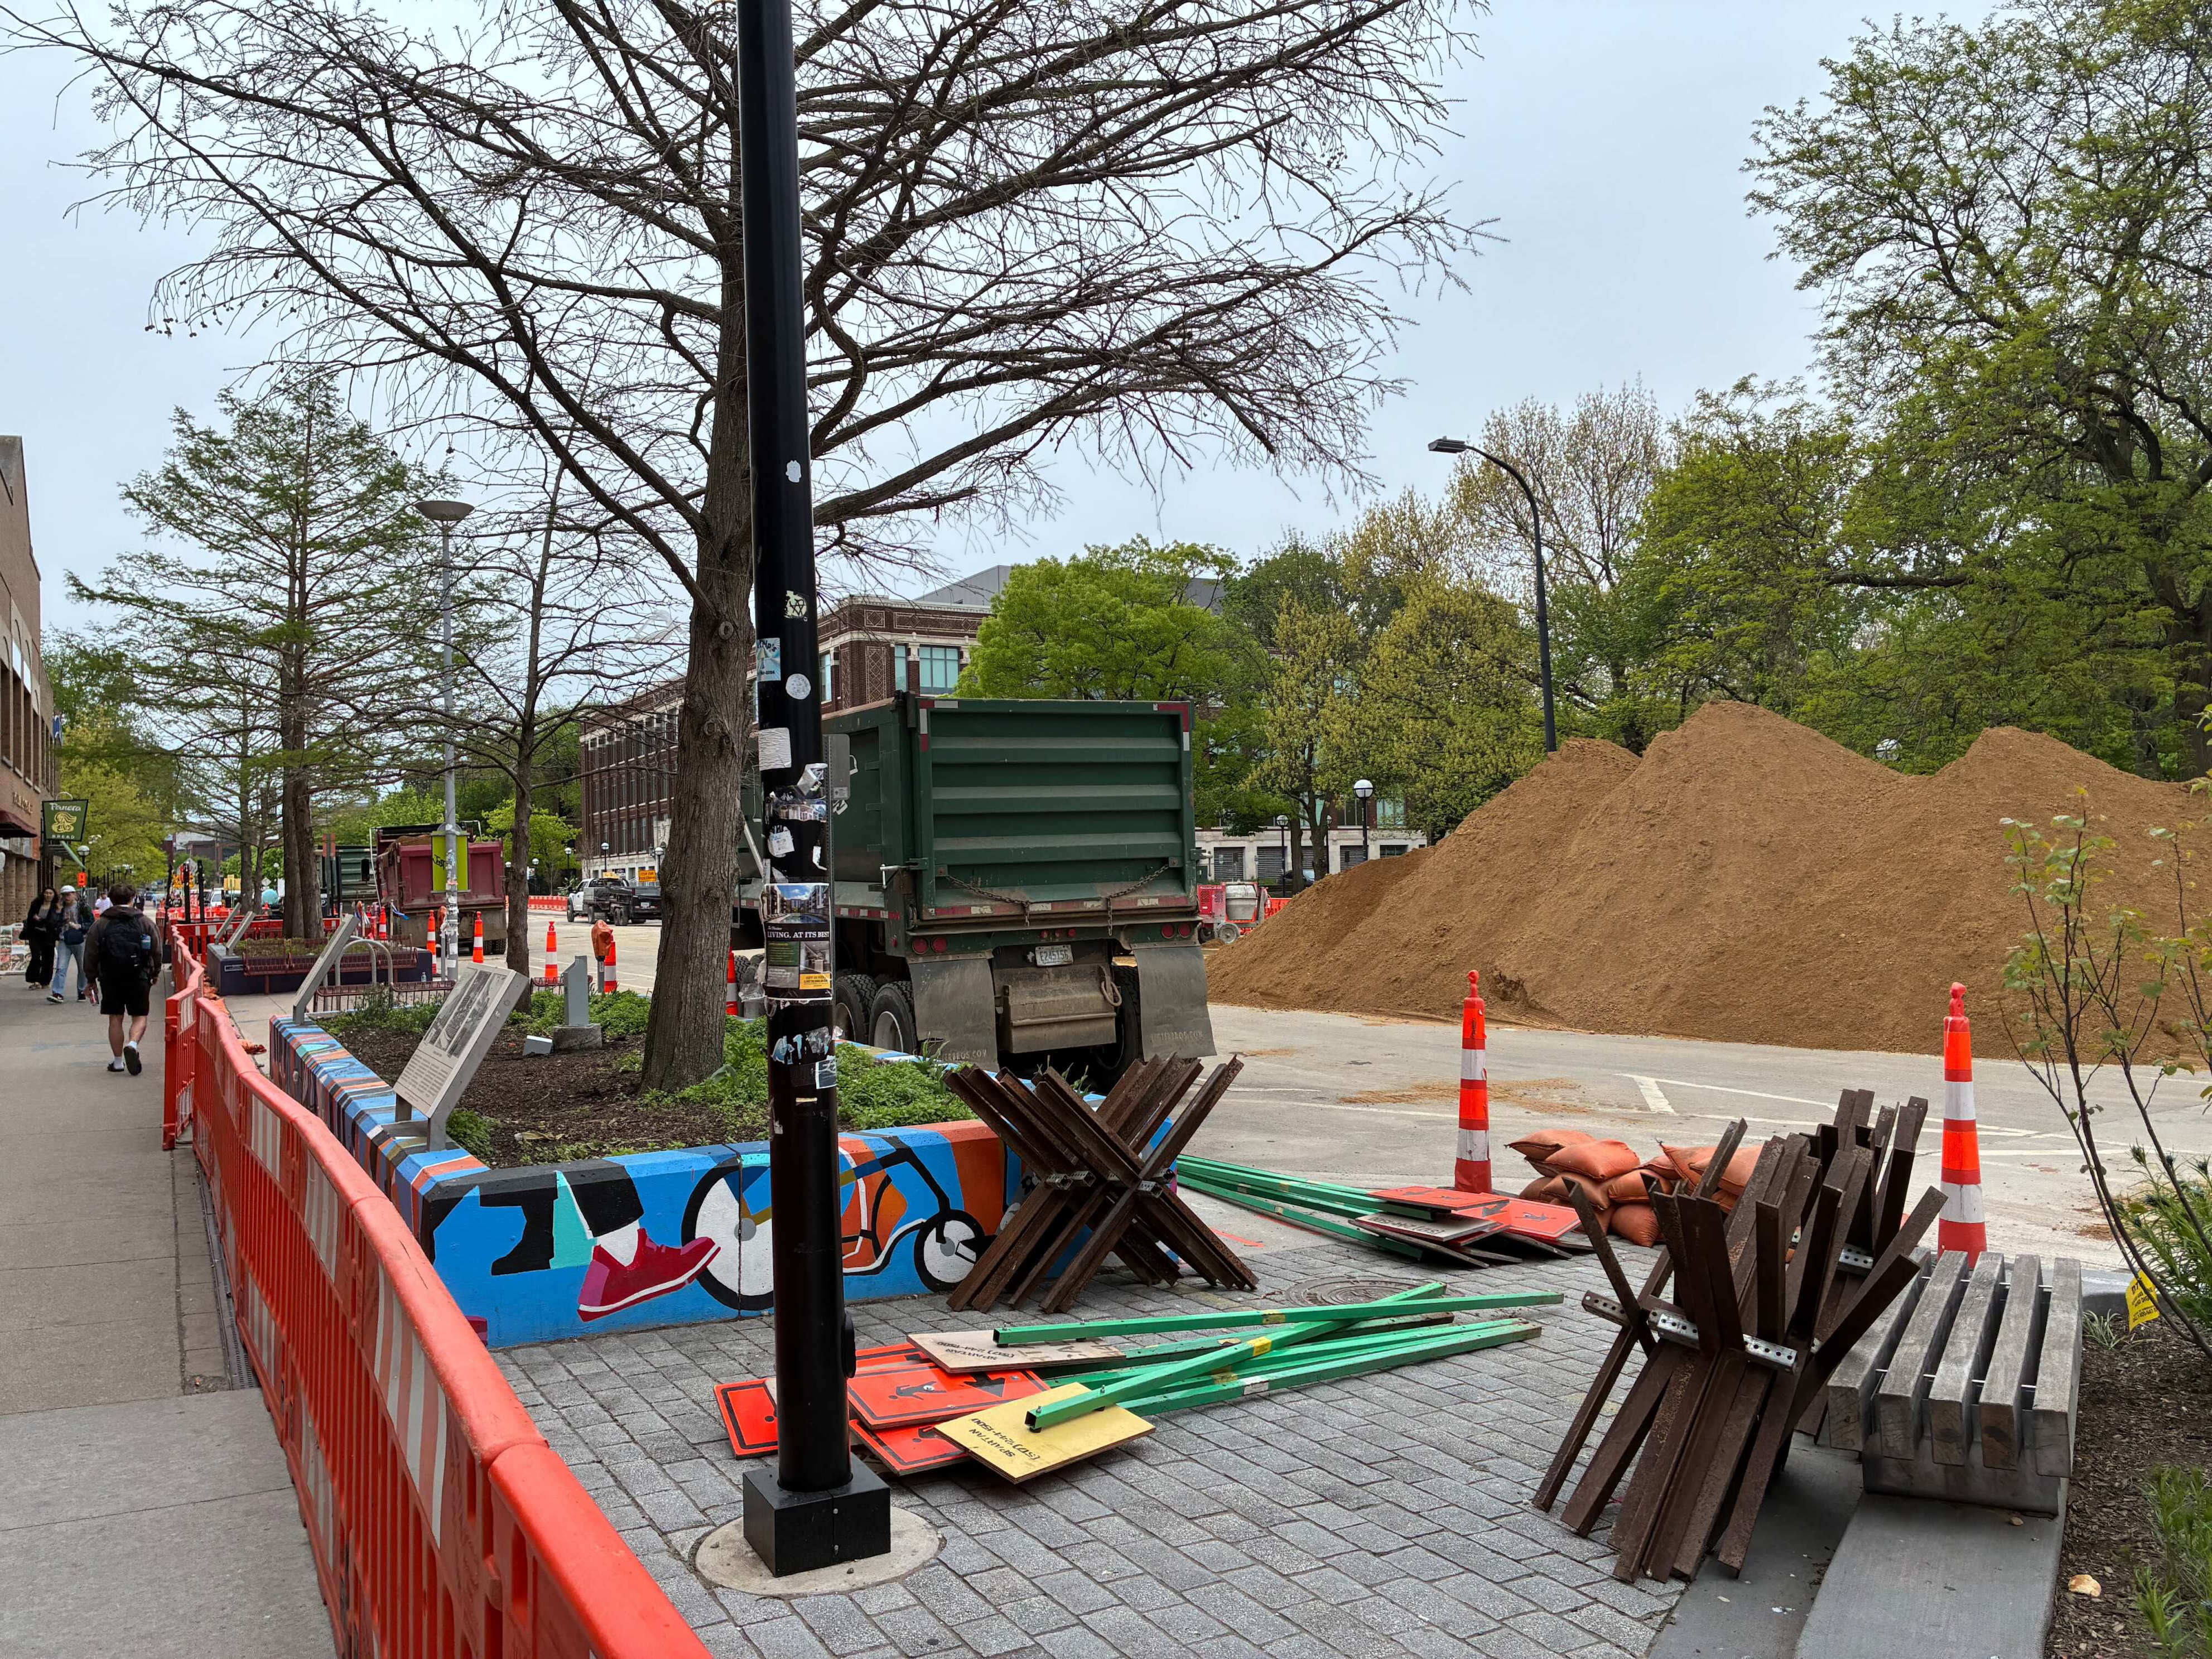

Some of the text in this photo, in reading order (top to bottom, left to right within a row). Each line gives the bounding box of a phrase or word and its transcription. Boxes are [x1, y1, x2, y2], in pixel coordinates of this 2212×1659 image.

[50, 803, 81, 811] Panera
[945, 1348, 997, 1361] SPARTAN
[969, 1429, 1015, 1457] SPARTAN
